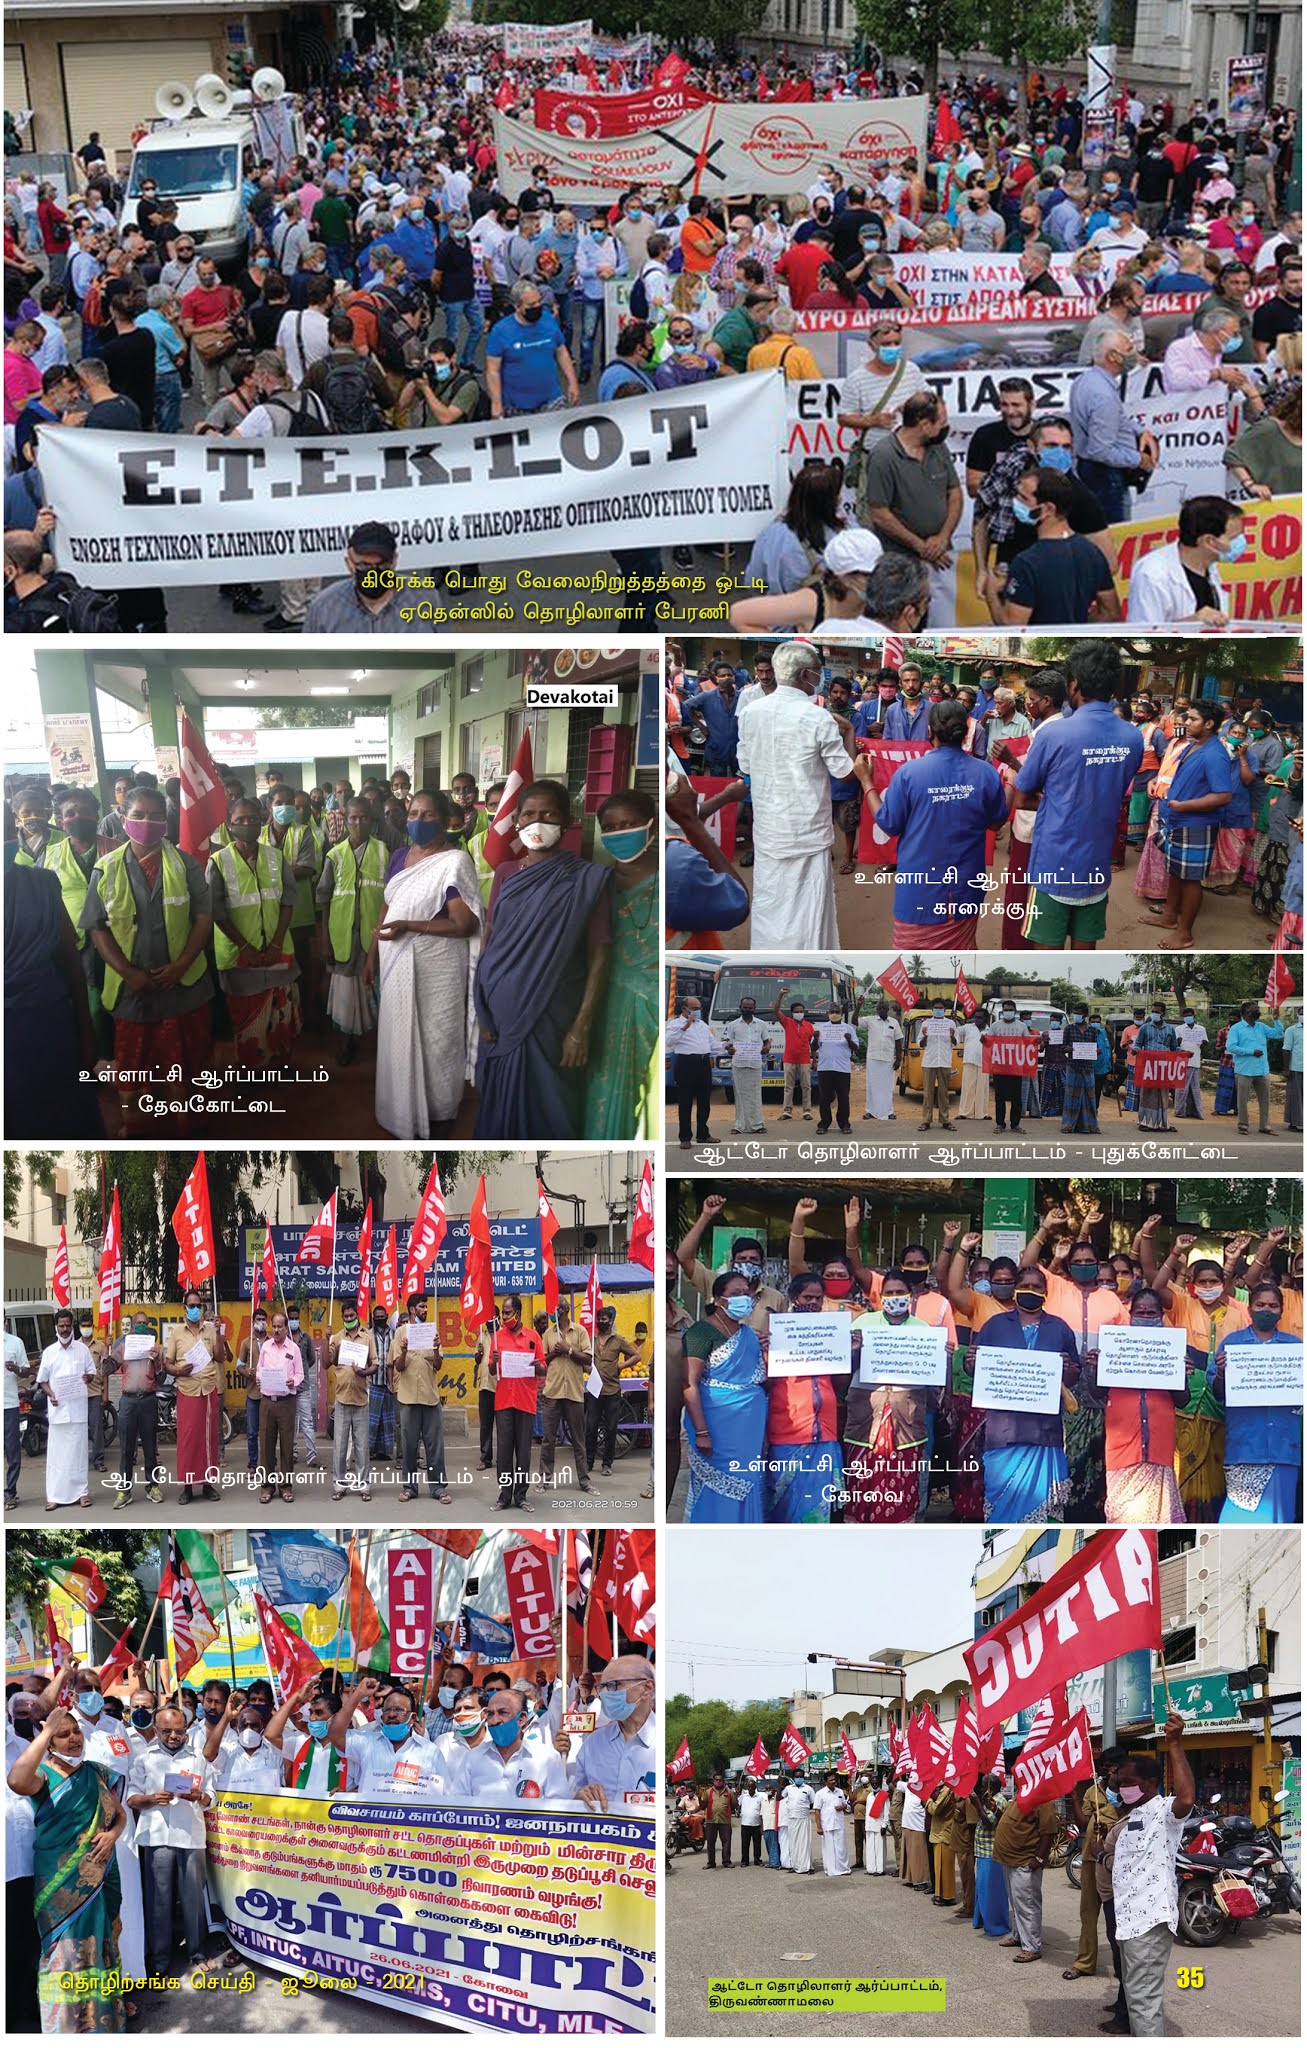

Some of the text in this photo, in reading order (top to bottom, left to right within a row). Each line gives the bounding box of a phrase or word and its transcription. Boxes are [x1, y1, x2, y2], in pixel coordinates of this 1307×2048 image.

[653, 92, 683, 109] ΟΧΙ
[901, 266, 969, 283] ΟΧΙ ΣΤΗΝ
[947, 301, 1028, 320] ΔΩΡΕΑΝ
[70, 484, 773, 563] ΕΝΩΣΗ ΤΕΧΝΙΚΩΝ ΕΛΛΗΝΙΚΟΥ & ΤΗΛΕΟΡΑΣΗΣ ΟΠΤΙΚΟΑΚΟΥΣΤΙΚΟΥ ΤΟΜΕΑ
[991, 1043, 1036, 1066] AITUC
[1143, 1060, 1186, 1081] AITUC
[512, 1275, 523, 1287] 636
[525, 1275, 536, 1286] 701
[392, 1552, 433, 1670] AITUC
[510, 1549, 555, 1654] AITUC
[396, 1766, 417, 1778] AITUC
[332, 1805, 641, 1839] விவசாயம் காப்போம்! ஜனநாயகம்
[294, 1820, 327, 1834] நான்கு
[327, 1823, 392, 1839] தொழிலாளர்
[393, 1830, 414, 1842] சட்ட
[416, 1831, 497, 1851] தொகுப்புகள்
[499, 1839, 551, 1857] மற்றும்
[557, 1844, 627, 1867] மின்சார
[308, 1837, 386, 1857] அனைவருக்கும்
[387, 1845, 471, 1869] கட்டணமின்றி
[473, 1854, 549, 1878] இருமுறை
[551, 1865, 616, 1885] தடுப்பூசி
[240, 1859, 578, 1929] நிறுவனங்களை தனியார்மயப்படுத்தும் கொள்கைகளை கைவிடு!
[262, 1849, 335, 1870] குடும்பங்களுக்கு
[336, 1860, 368, 1875] மாதம்
[369, 1865, 383, 1878] ரூ
[384, 1863, 457, 1888] 7500
[461, 1877, 535, 1900] நிவாரணம்
[538, 1888, 603, 1910] வழங்கு!
[415, 1908, 503, 1933] அனைத்து
[250, 1930, 308, 1965] INTUC,
[312, 1951, 383, 1988] AITUC,
[467, 1993, 547, 2034] CITU,
[369, 1951, 529, 1999] 26.06.2021 கோவை
